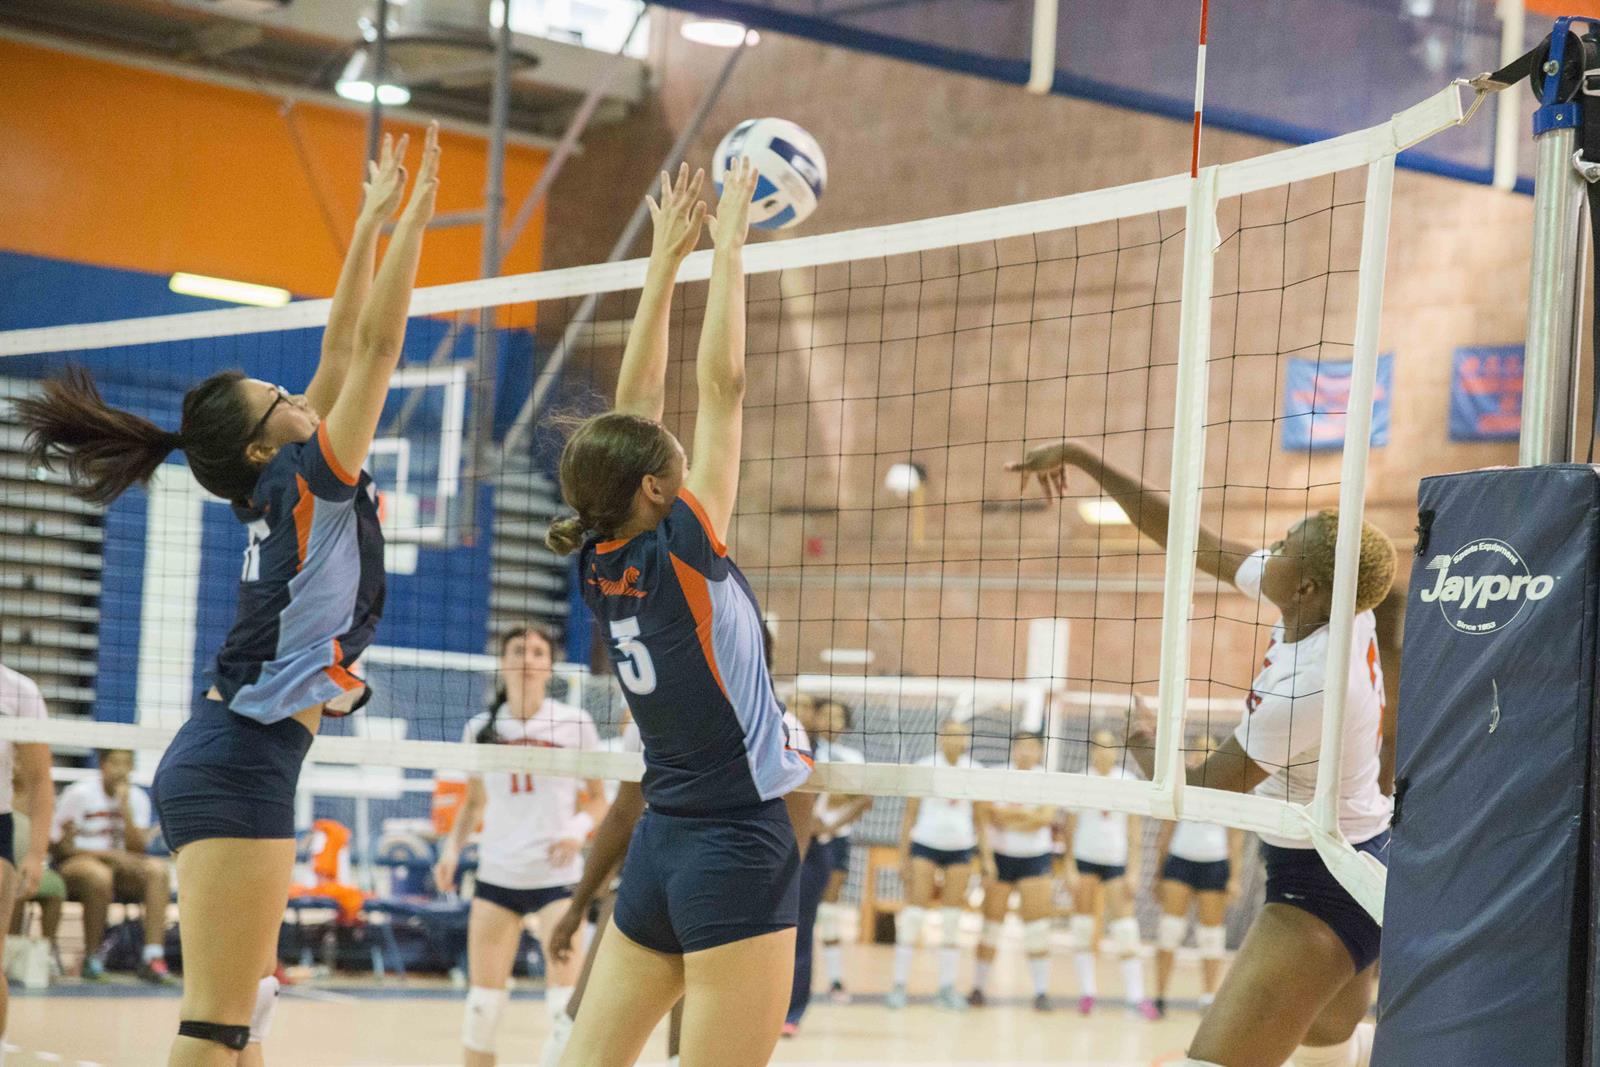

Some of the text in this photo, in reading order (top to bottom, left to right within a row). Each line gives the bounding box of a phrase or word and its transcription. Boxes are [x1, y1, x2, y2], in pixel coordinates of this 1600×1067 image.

[1479, 542, 1519, 566] Equipment
[1420, 554, 1554, 609] Jaypro
[1456, 620, 1477, 631] Since
[609, 615, 657, 695] 5
